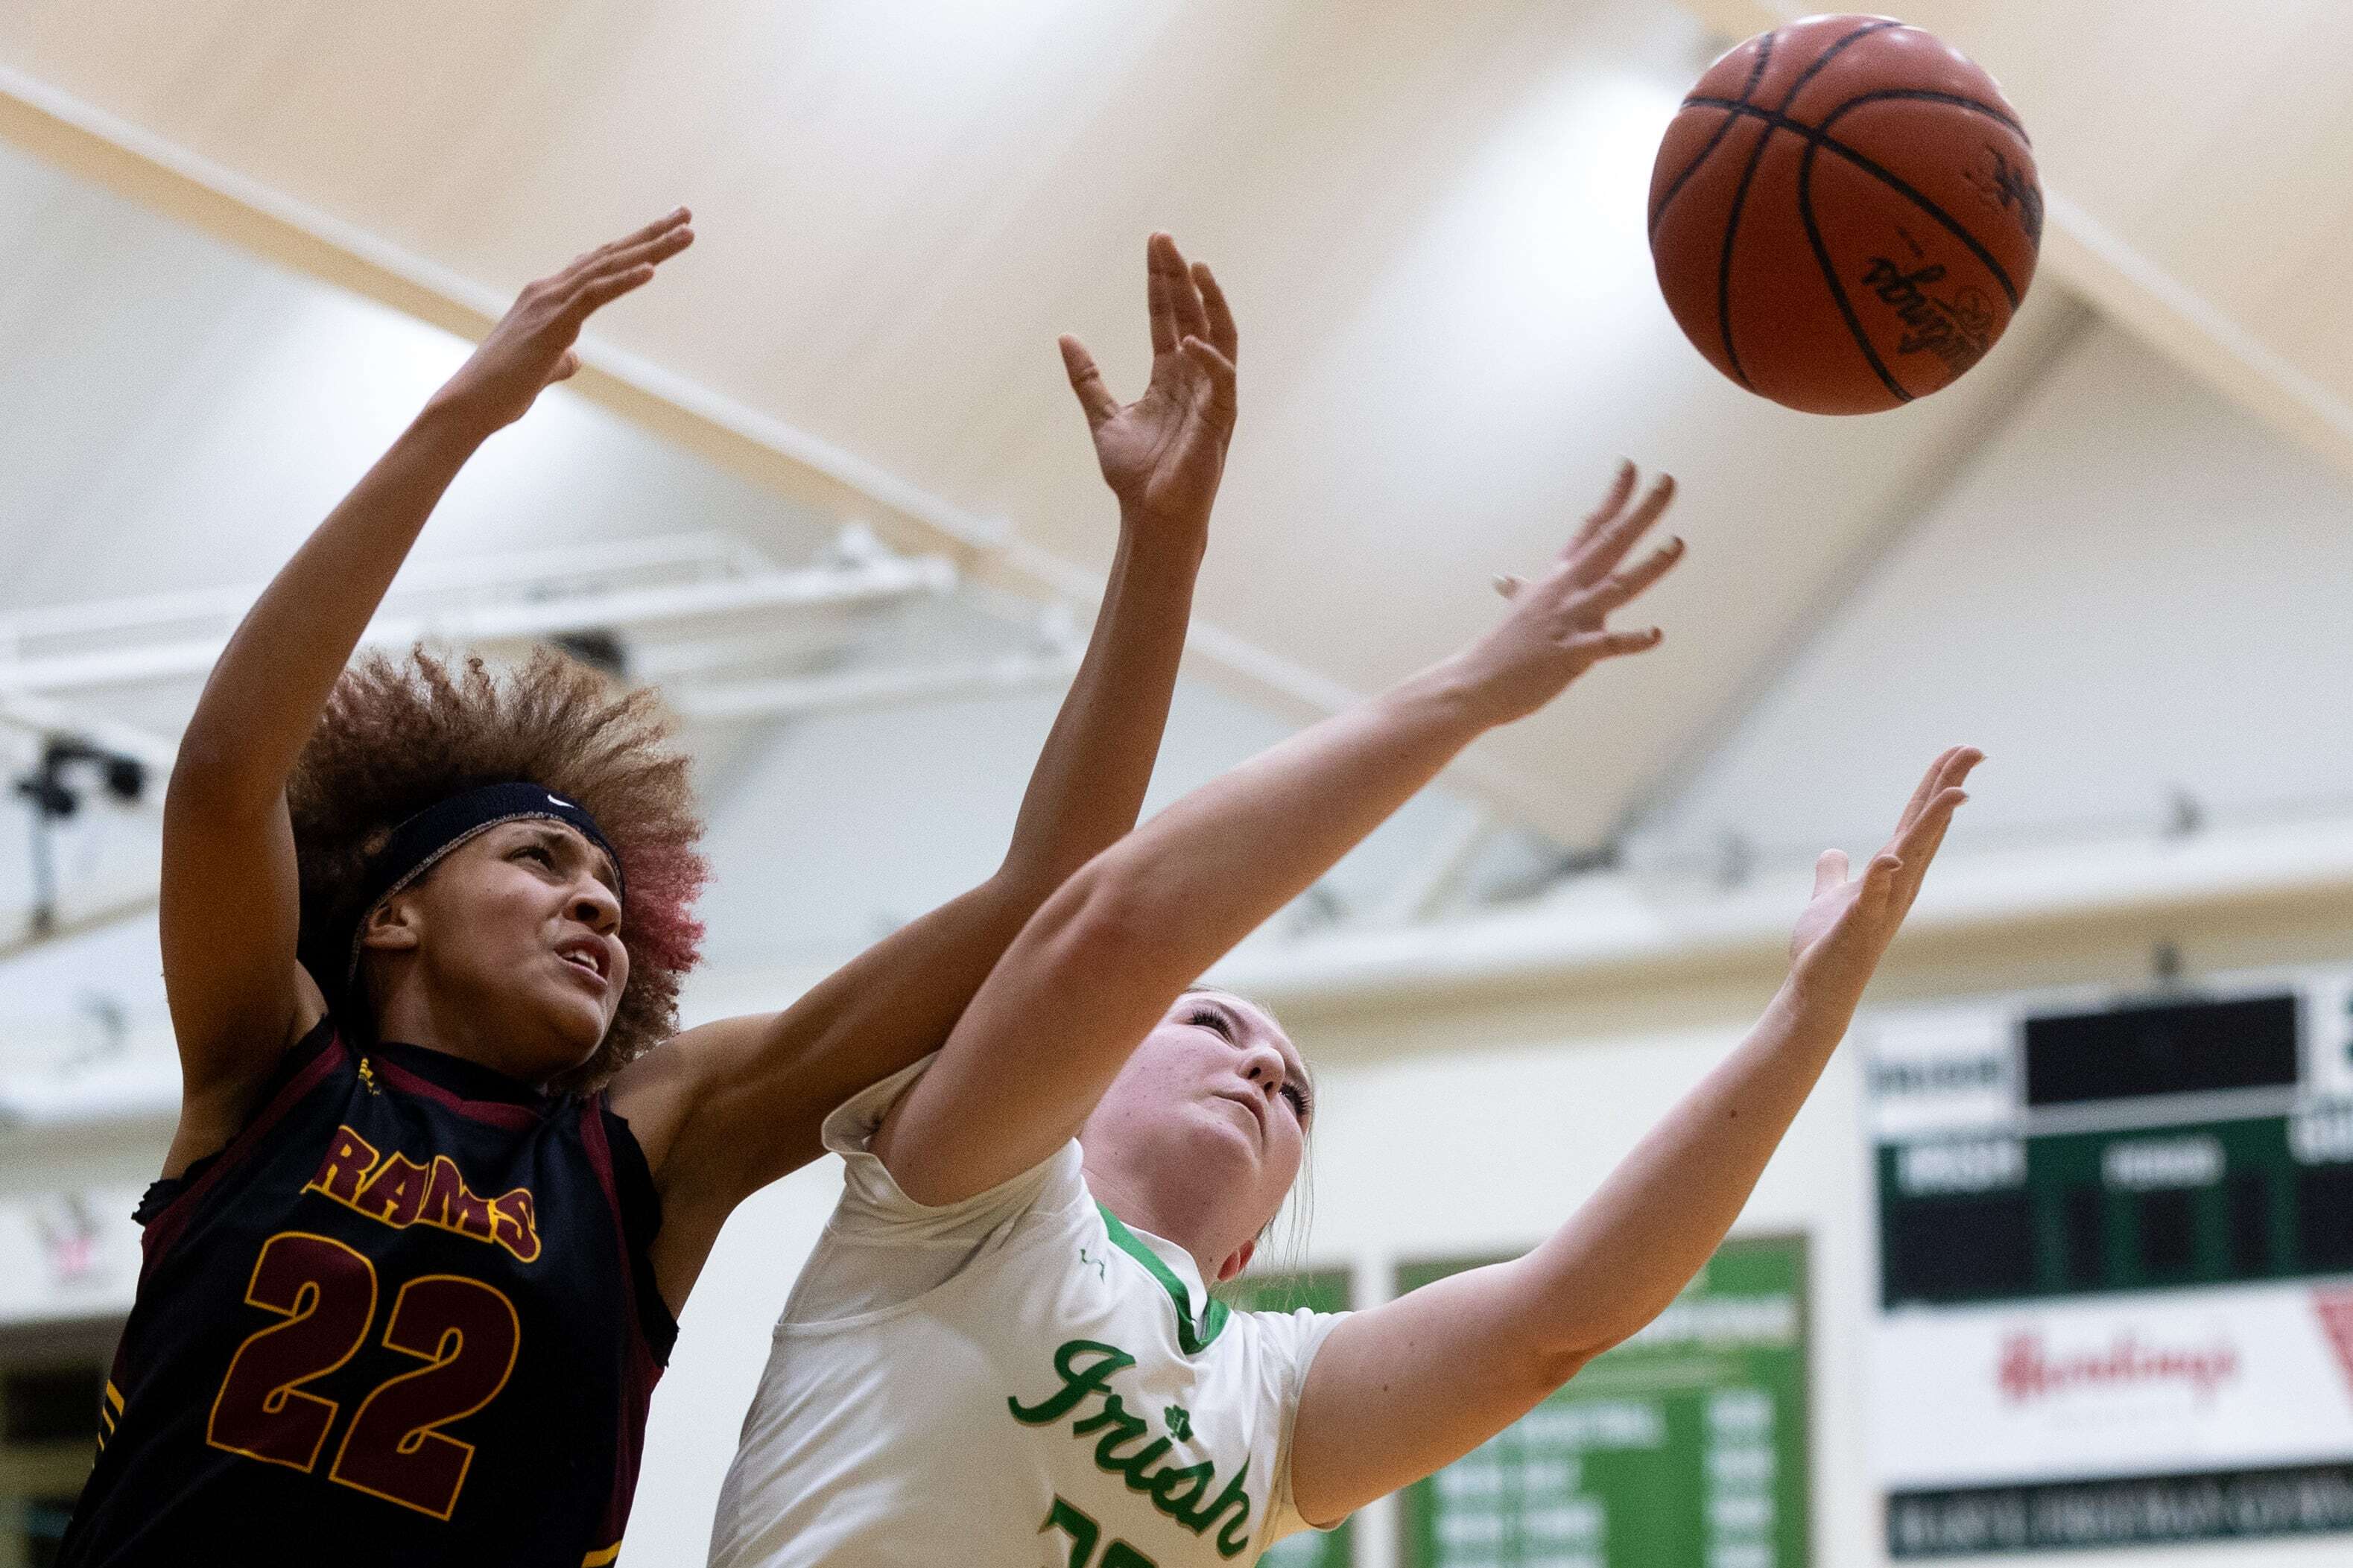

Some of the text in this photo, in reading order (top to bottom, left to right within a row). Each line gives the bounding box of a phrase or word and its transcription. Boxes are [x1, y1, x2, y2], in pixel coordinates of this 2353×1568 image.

[302, 1124, 542, 1263] RAMS
[206, 1231, 521, 1521] 22
[1007, 1339, 1252, 1561] Irish
